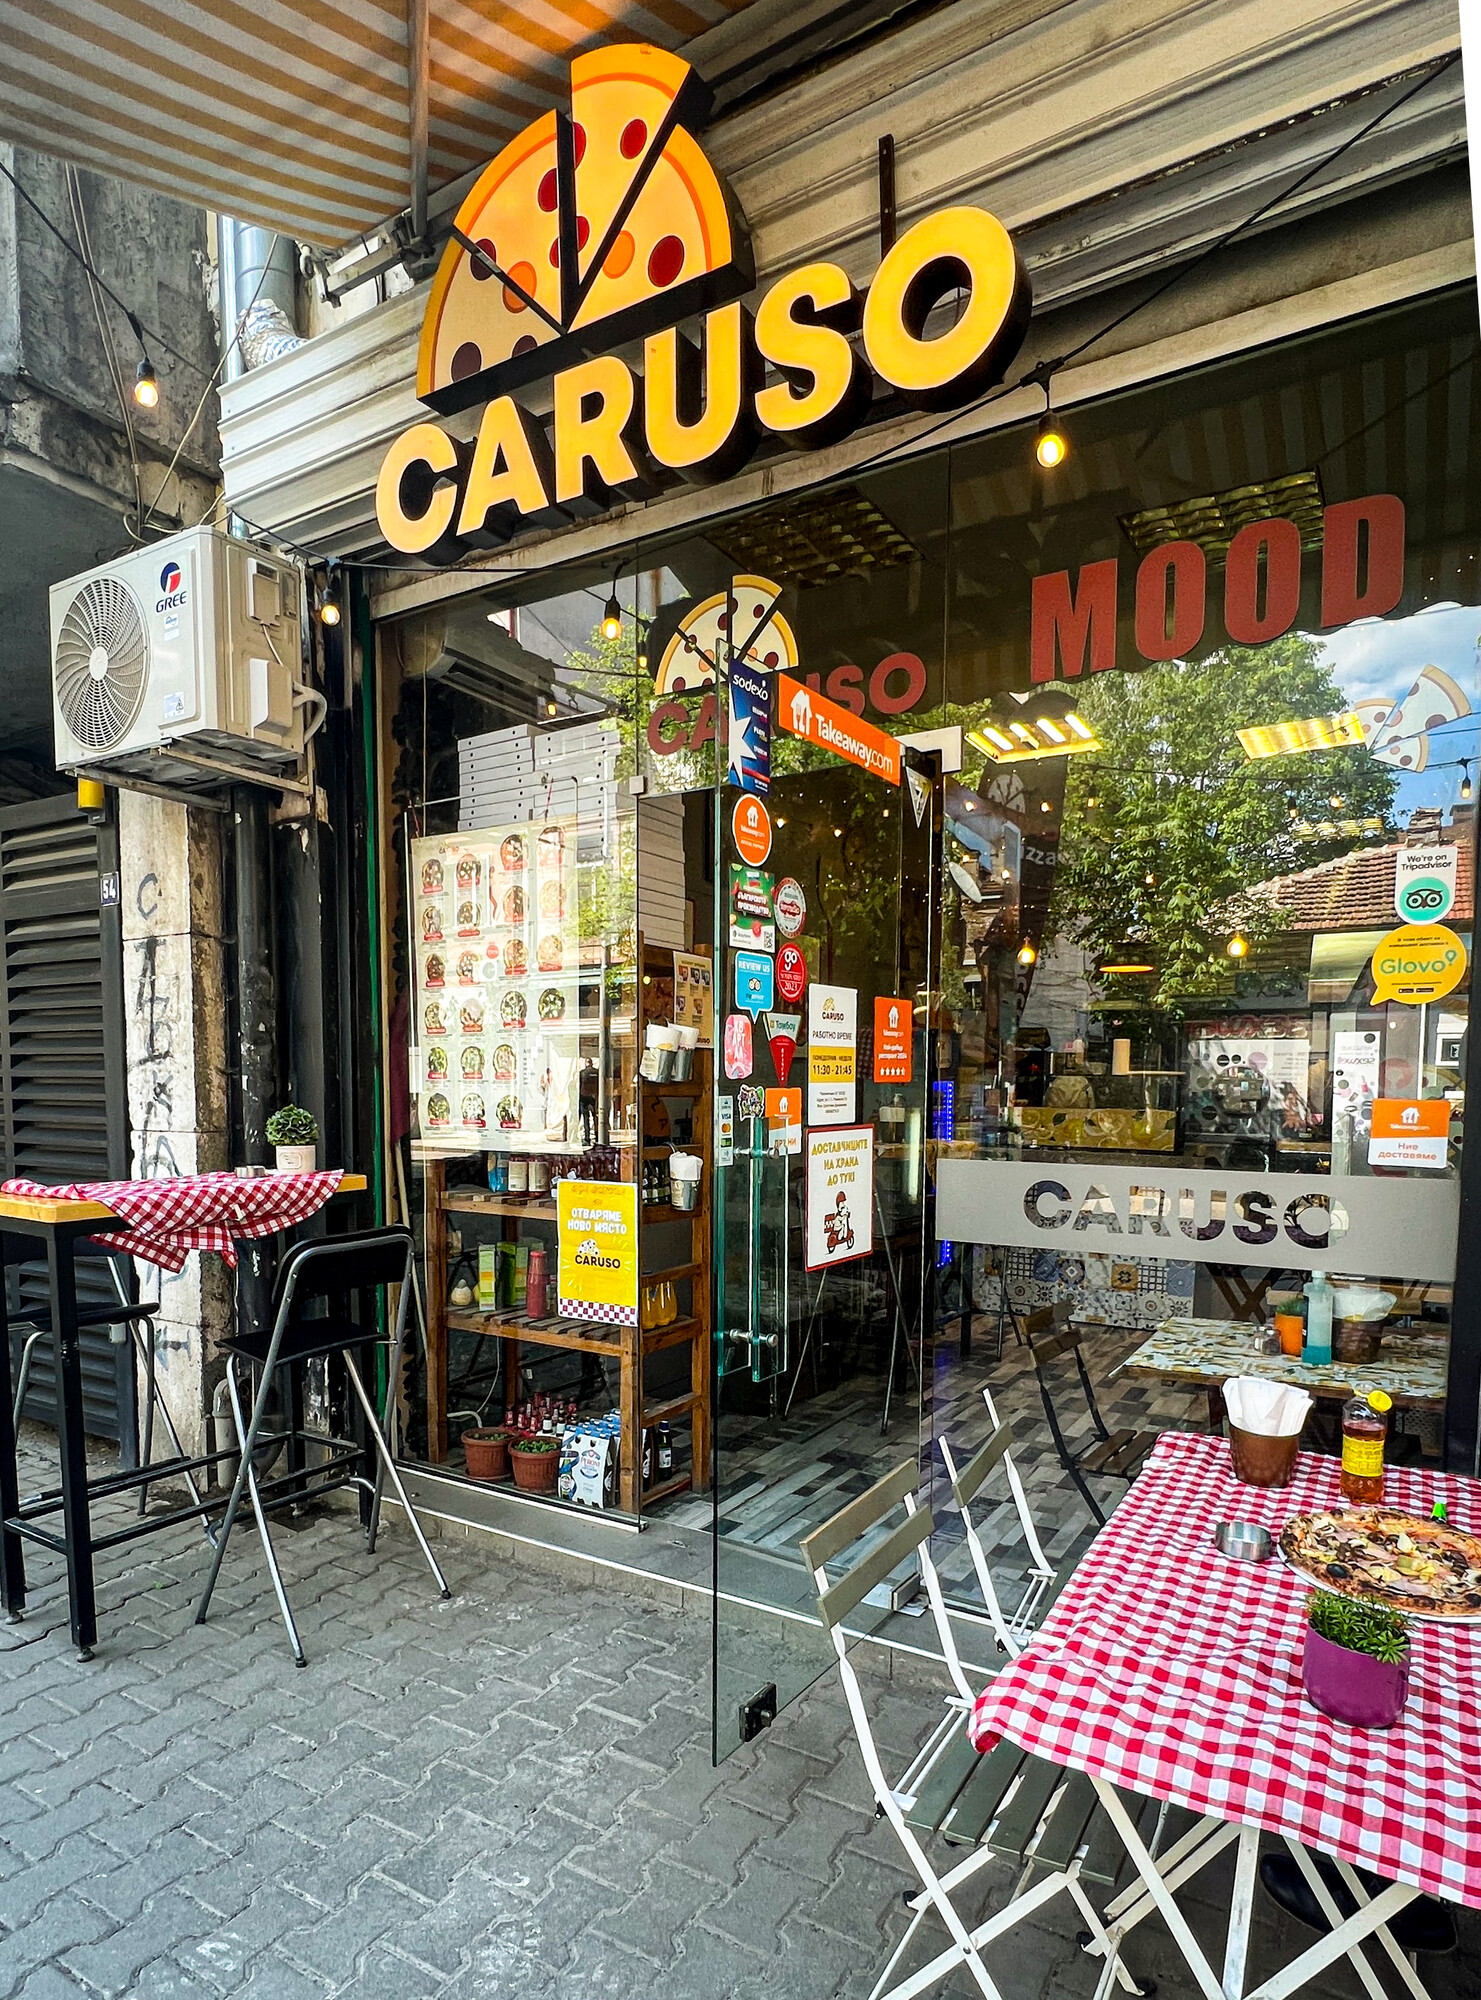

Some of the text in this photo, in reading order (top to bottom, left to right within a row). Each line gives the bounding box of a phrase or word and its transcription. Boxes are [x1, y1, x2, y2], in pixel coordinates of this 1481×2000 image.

[375, 205, 1020, 553] CARUSO
[1031, 494, 1405, 683] MOOD
[155, 590, 187, 613] GREE
[733, 674, 769, 701] sodexo
[815, 713, 893, 774] Takeaway.com
[1401, 861, 1453, 871] Tripadvisor
[1406, 855, 1433, 863] We're
[102, 875, 117, 900] 54
[738, 960, 771, 973] REVIEW US
[1380, 957, 1446, 975] Glovo
[821, 1011, 845, 1021] CARUSO
[812, 1030, 852, 1040] РАБОТНО ВРЕМЕ
[813, 1064, 831, 1075] 11:30
[835, 1065, 852, 1075] 21:45
[1397, 1142, 1419, 1150] Ние
[824, 1156, 859, 1170] НА ХРАНА
[1377, 1151, 1437, 1161] доставяме
[827, 1173, 838, 1186] ДО
[571, 1207, 622, 1222] ОТВАРЯМЕ
[1023, 1180, 1350, 1250] CARUSO
[567, 1219, 627, 1235] НОВО МЯСТО
[575, 1254, 621, 1269] CARUSO
